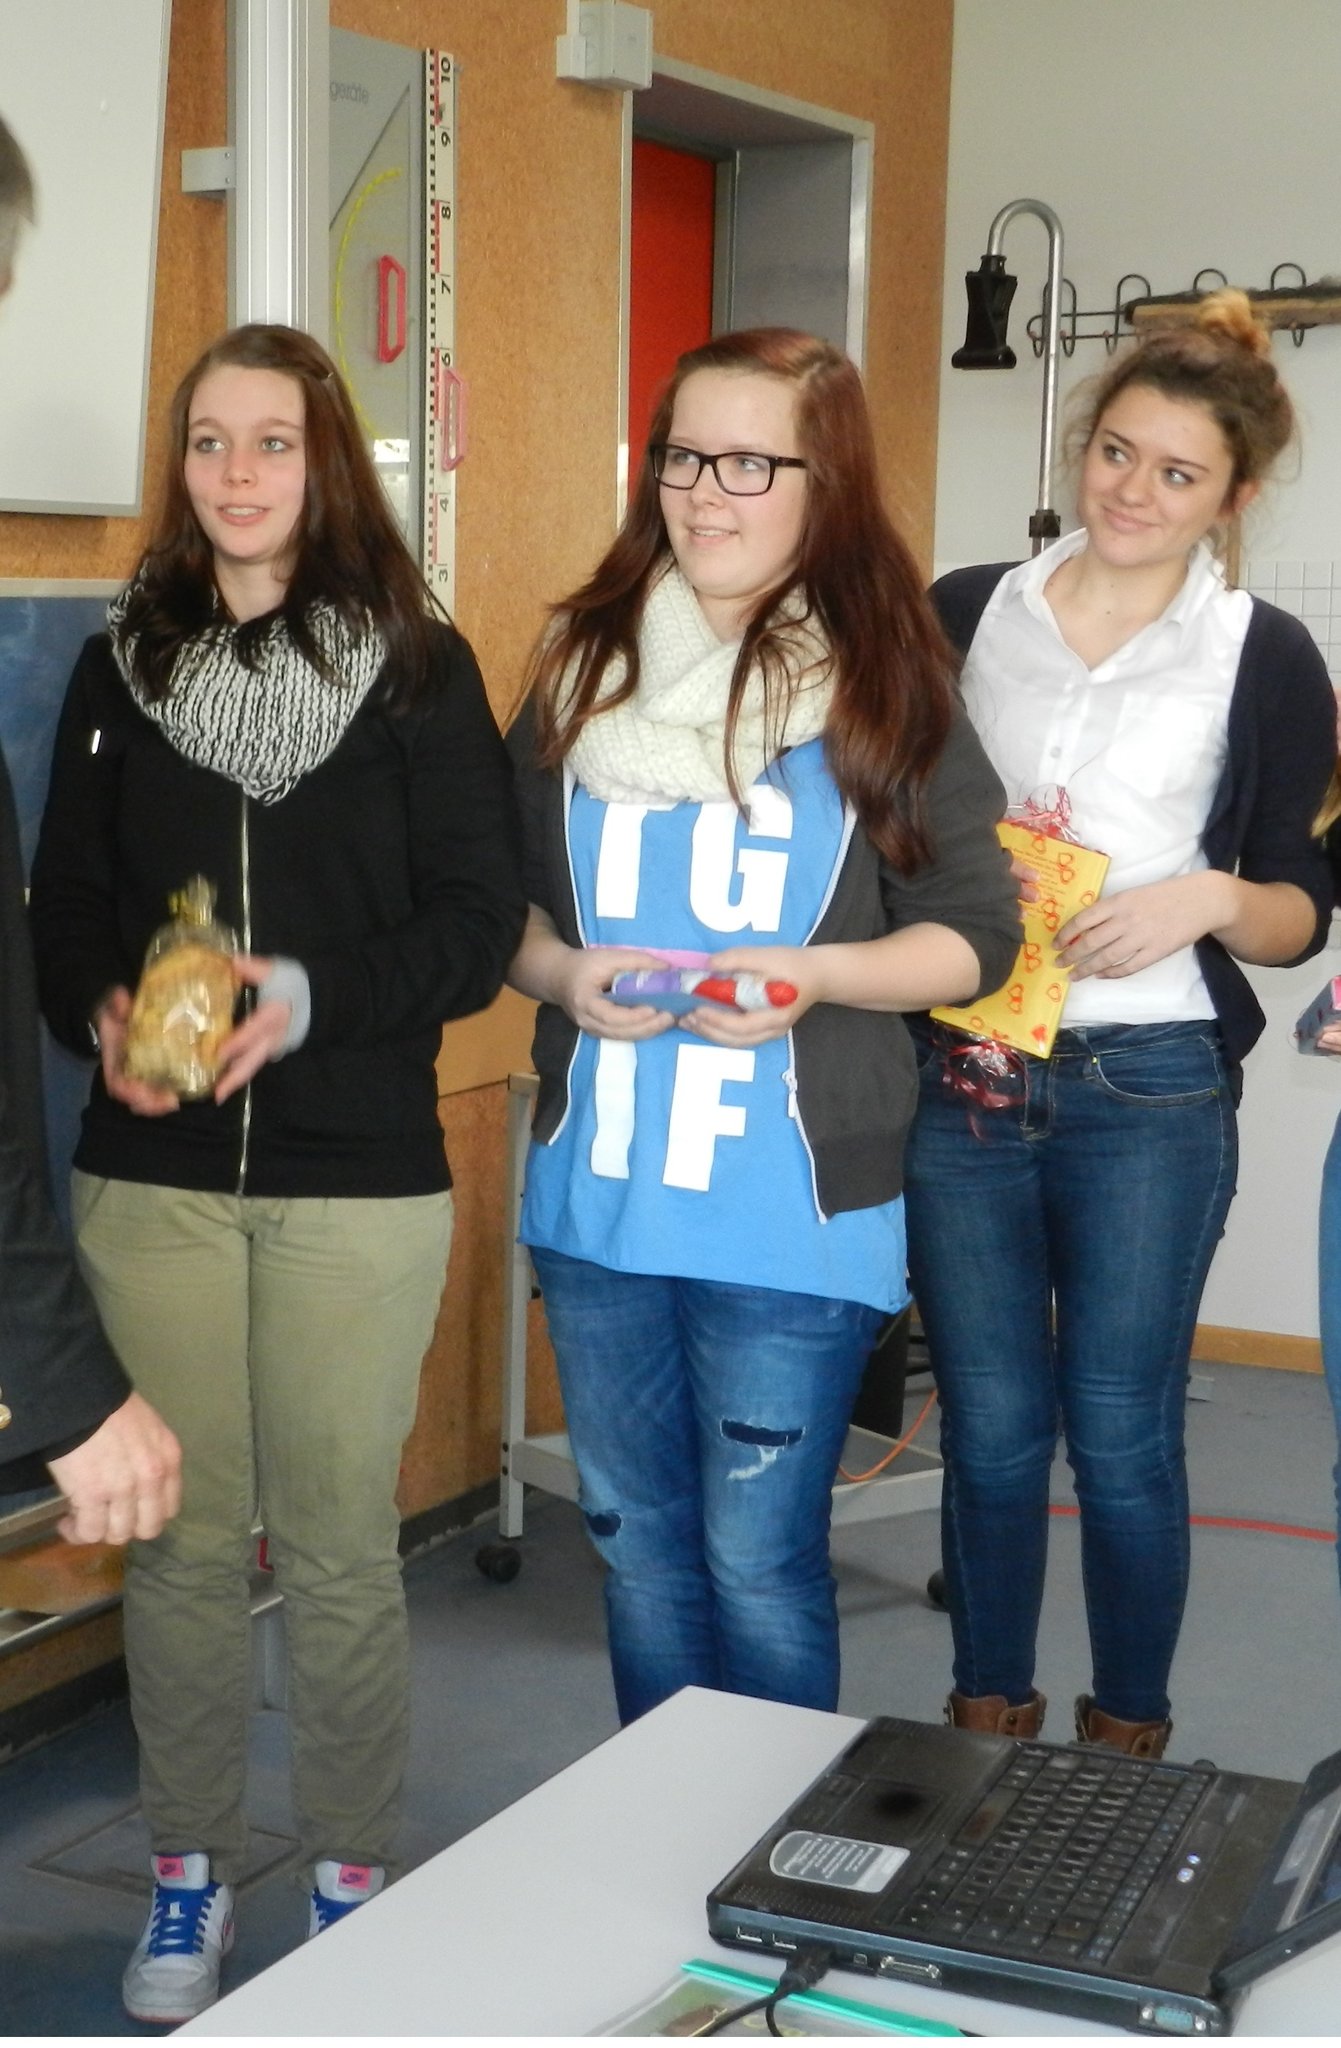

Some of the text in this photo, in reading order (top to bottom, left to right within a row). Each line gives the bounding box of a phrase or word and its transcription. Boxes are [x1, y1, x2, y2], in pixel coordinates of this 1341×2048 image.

[441, 56, 450, 83] 10
[441, 131, 450, 147] 9
[441, 206, 450, 219] 8
[441, 280, 450, 294] 7
[441, 352, 450, 366] 6
[440, 499, 448, 512] 4
[438, 569, 447, 582] 3
[589, 784, 793, 932] TG
